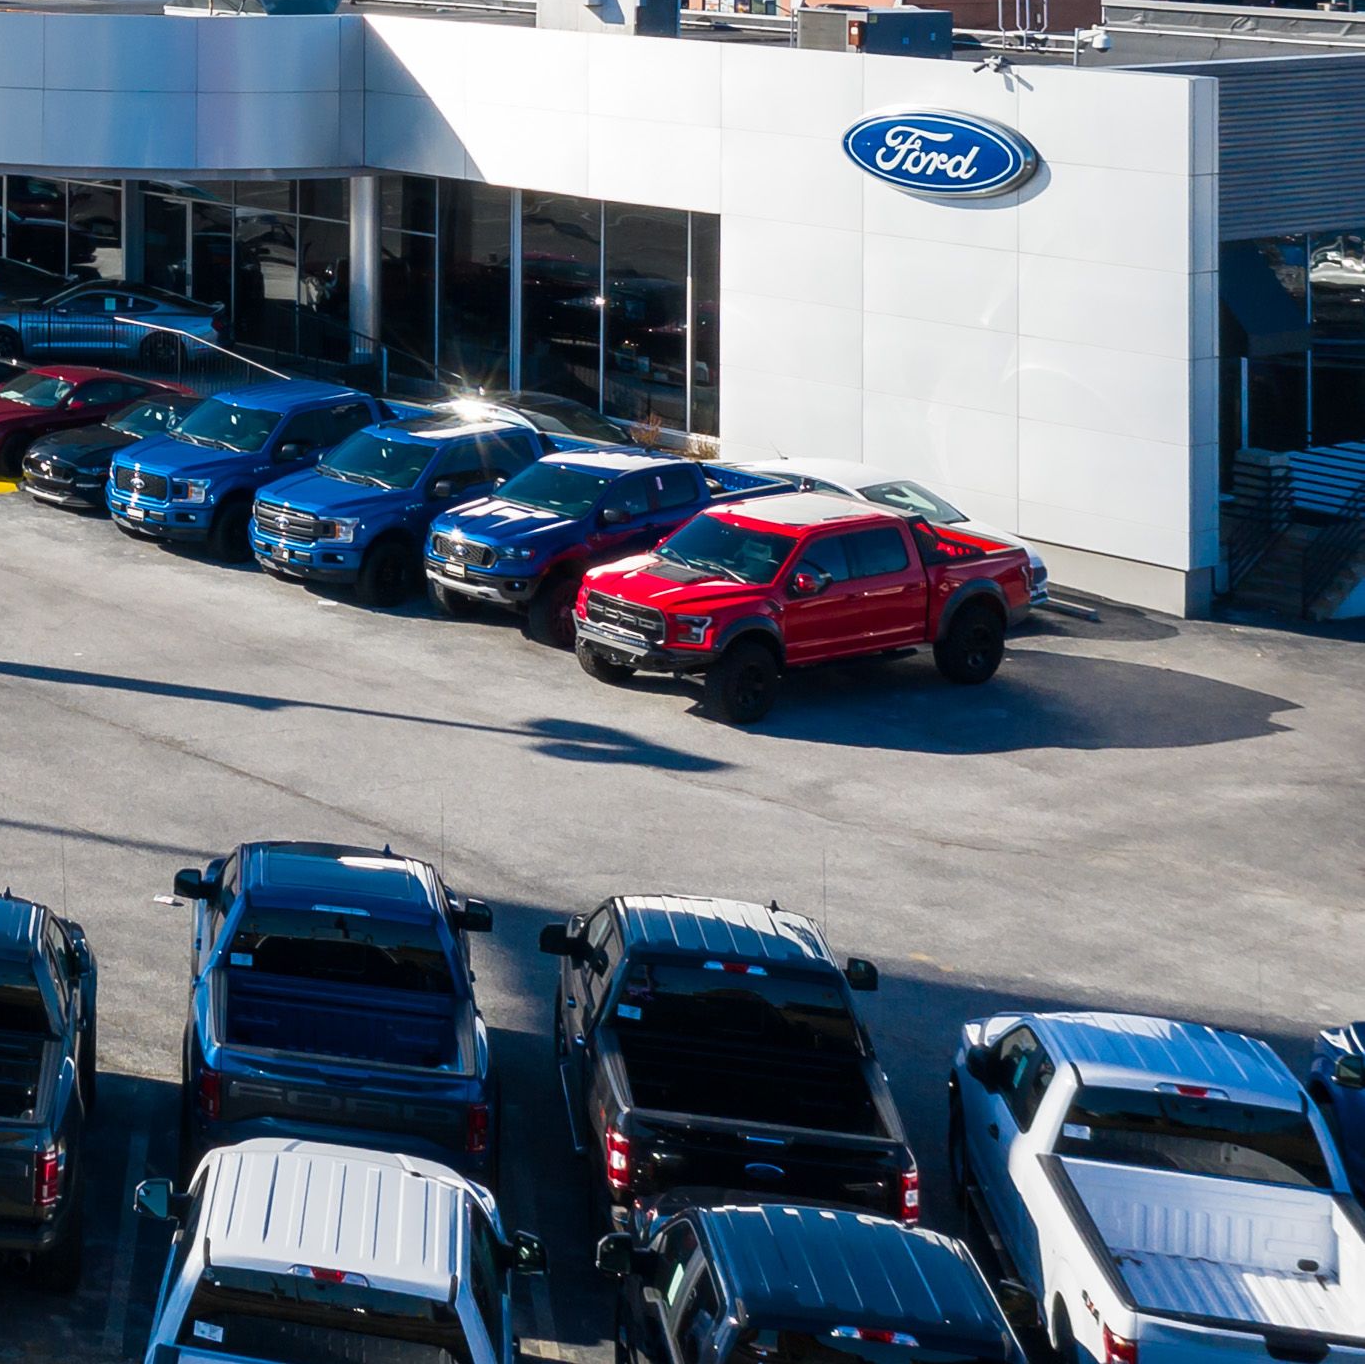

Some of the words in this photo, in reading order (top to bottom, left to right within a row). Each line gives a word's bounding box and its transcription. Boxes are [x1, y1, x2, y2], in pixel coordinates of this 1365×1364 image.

[875, 125, 981, 180] Ford
[587, 600, 657, 630] FORD
[229, 1081, 457, 1122] FORD
